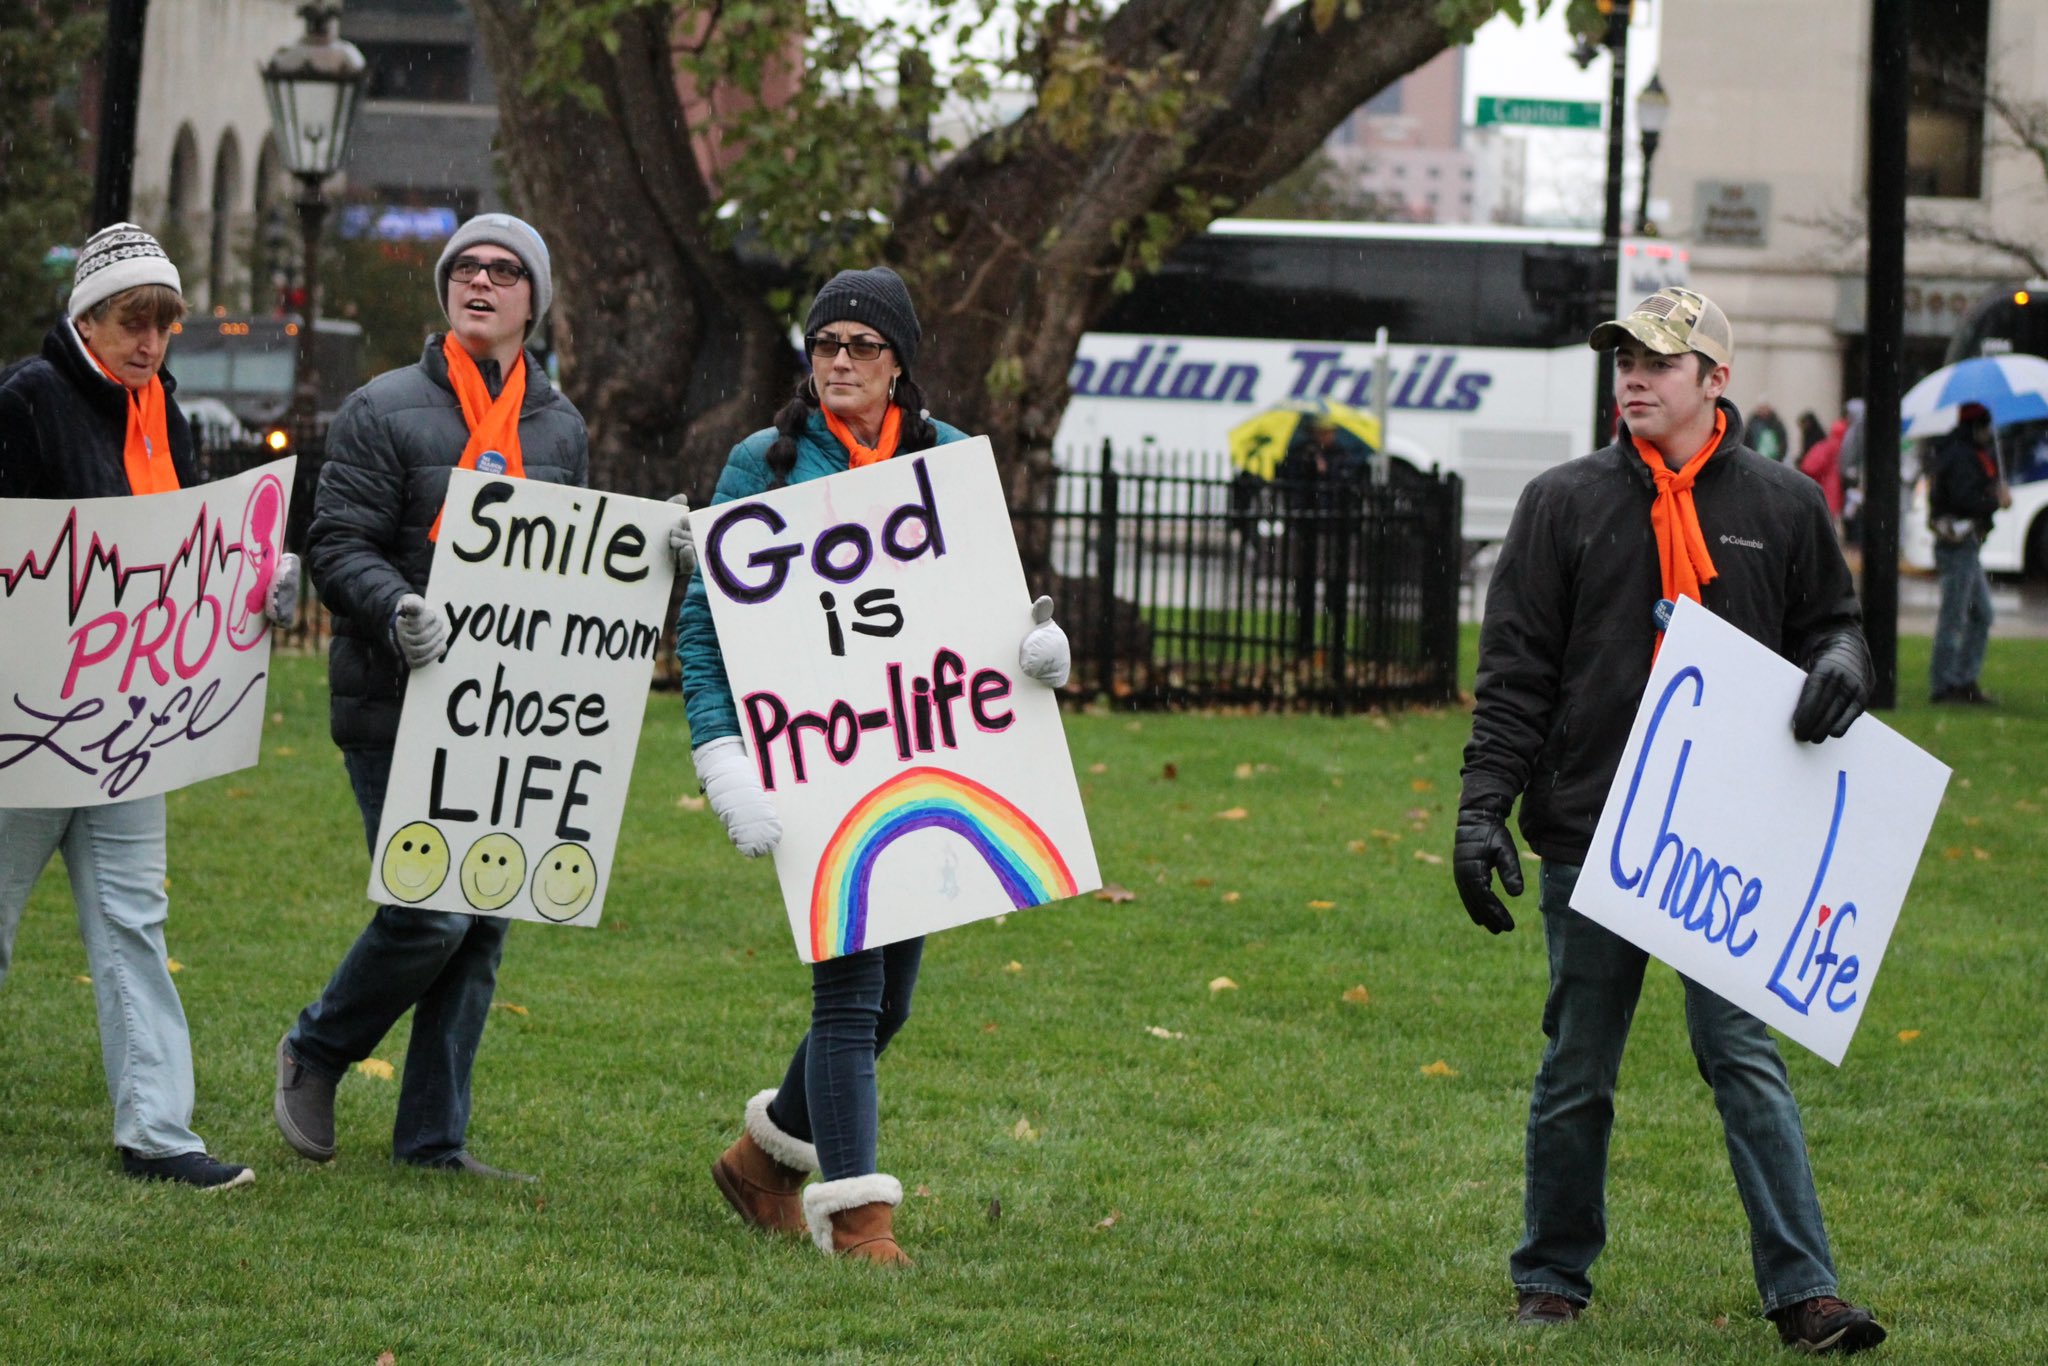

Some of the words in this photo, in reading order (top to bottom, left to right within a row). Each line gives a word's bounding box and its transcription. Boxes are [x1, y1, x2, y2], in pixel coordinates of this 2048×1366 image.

[1067, 343, 1259, 402] ndian
[453, 482, 649, 582] Smile
[705, 457, 945, 604] God
[1728, 535, 1764, 549] Columbia
[61, 595, 221, 699] PRO
[438, 602, 550, 662] your
[562, 614, 660, 660] mom
[819, 588, 904, 656] is
[0, 672, 265, 798] Life
[741, 647, 1015, 791] Pro-life
[429, 748, 602, 841] LIFE
[1610, 666, 1763, 957] Choose
[1766, 770, 1859, 1016] Life
